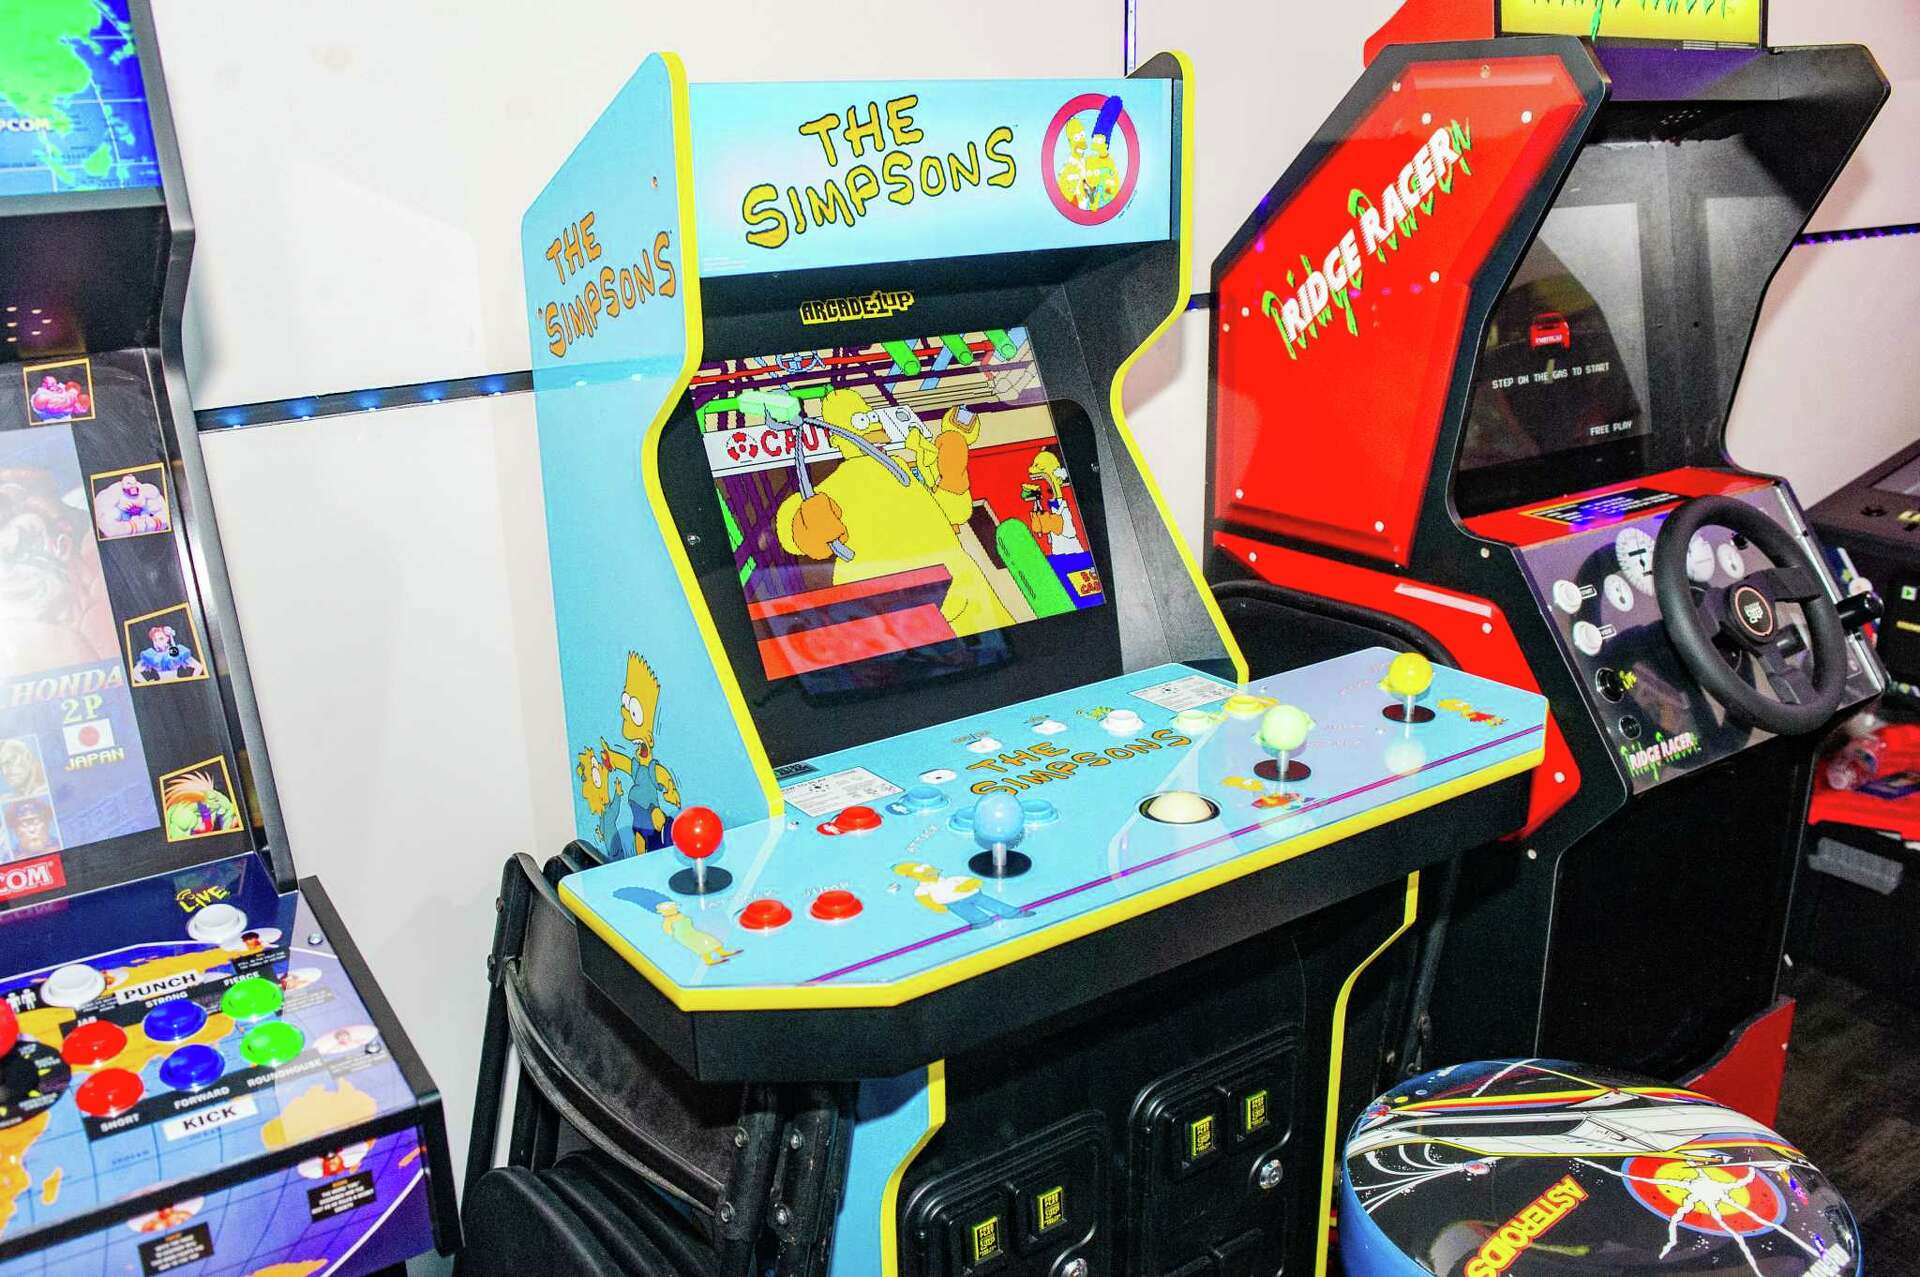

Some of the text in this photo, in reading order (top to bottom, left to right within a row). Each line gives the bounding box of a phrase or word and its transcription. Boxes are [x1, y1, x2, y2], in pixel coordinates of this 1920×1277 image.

[799, 94, 925, 167] THE
[742, 126, 1017, 249] SIMPSONS
[545, 211, 602, 285] THE
[1280, 126, 1462, 343] RIDGE RACER
[544, 230, 677, 358] SIMPSONS
[1491, 361, 1610, 390] STEP ON THE GAS TO START
[1589, 420, 1633, 437] FREE PLAY
[62, 692, 103, 724] 2P
[64, 746, 125, 772] JAPAN
[966, 741, 1070, 774] THE
[969, 728, 1192, 797] SIMPSONS
[1629, 744, 1662, 771] RIDGE
[123, 973, 197, 1000] PUNCH
[223, 971, 261, 987] FIERCE
[144, 991, 189, 1009] STRONG
[100, 1112, 140, 1133] SHORT
[173, 1086, 231, 1111] FORWARD
[246, 1058, 323, 1088] ROUNDHOUSE
[183, 1105, 238, 1131] KICK
[1464, 1174, 1588, 1277] ASTEROIDS
